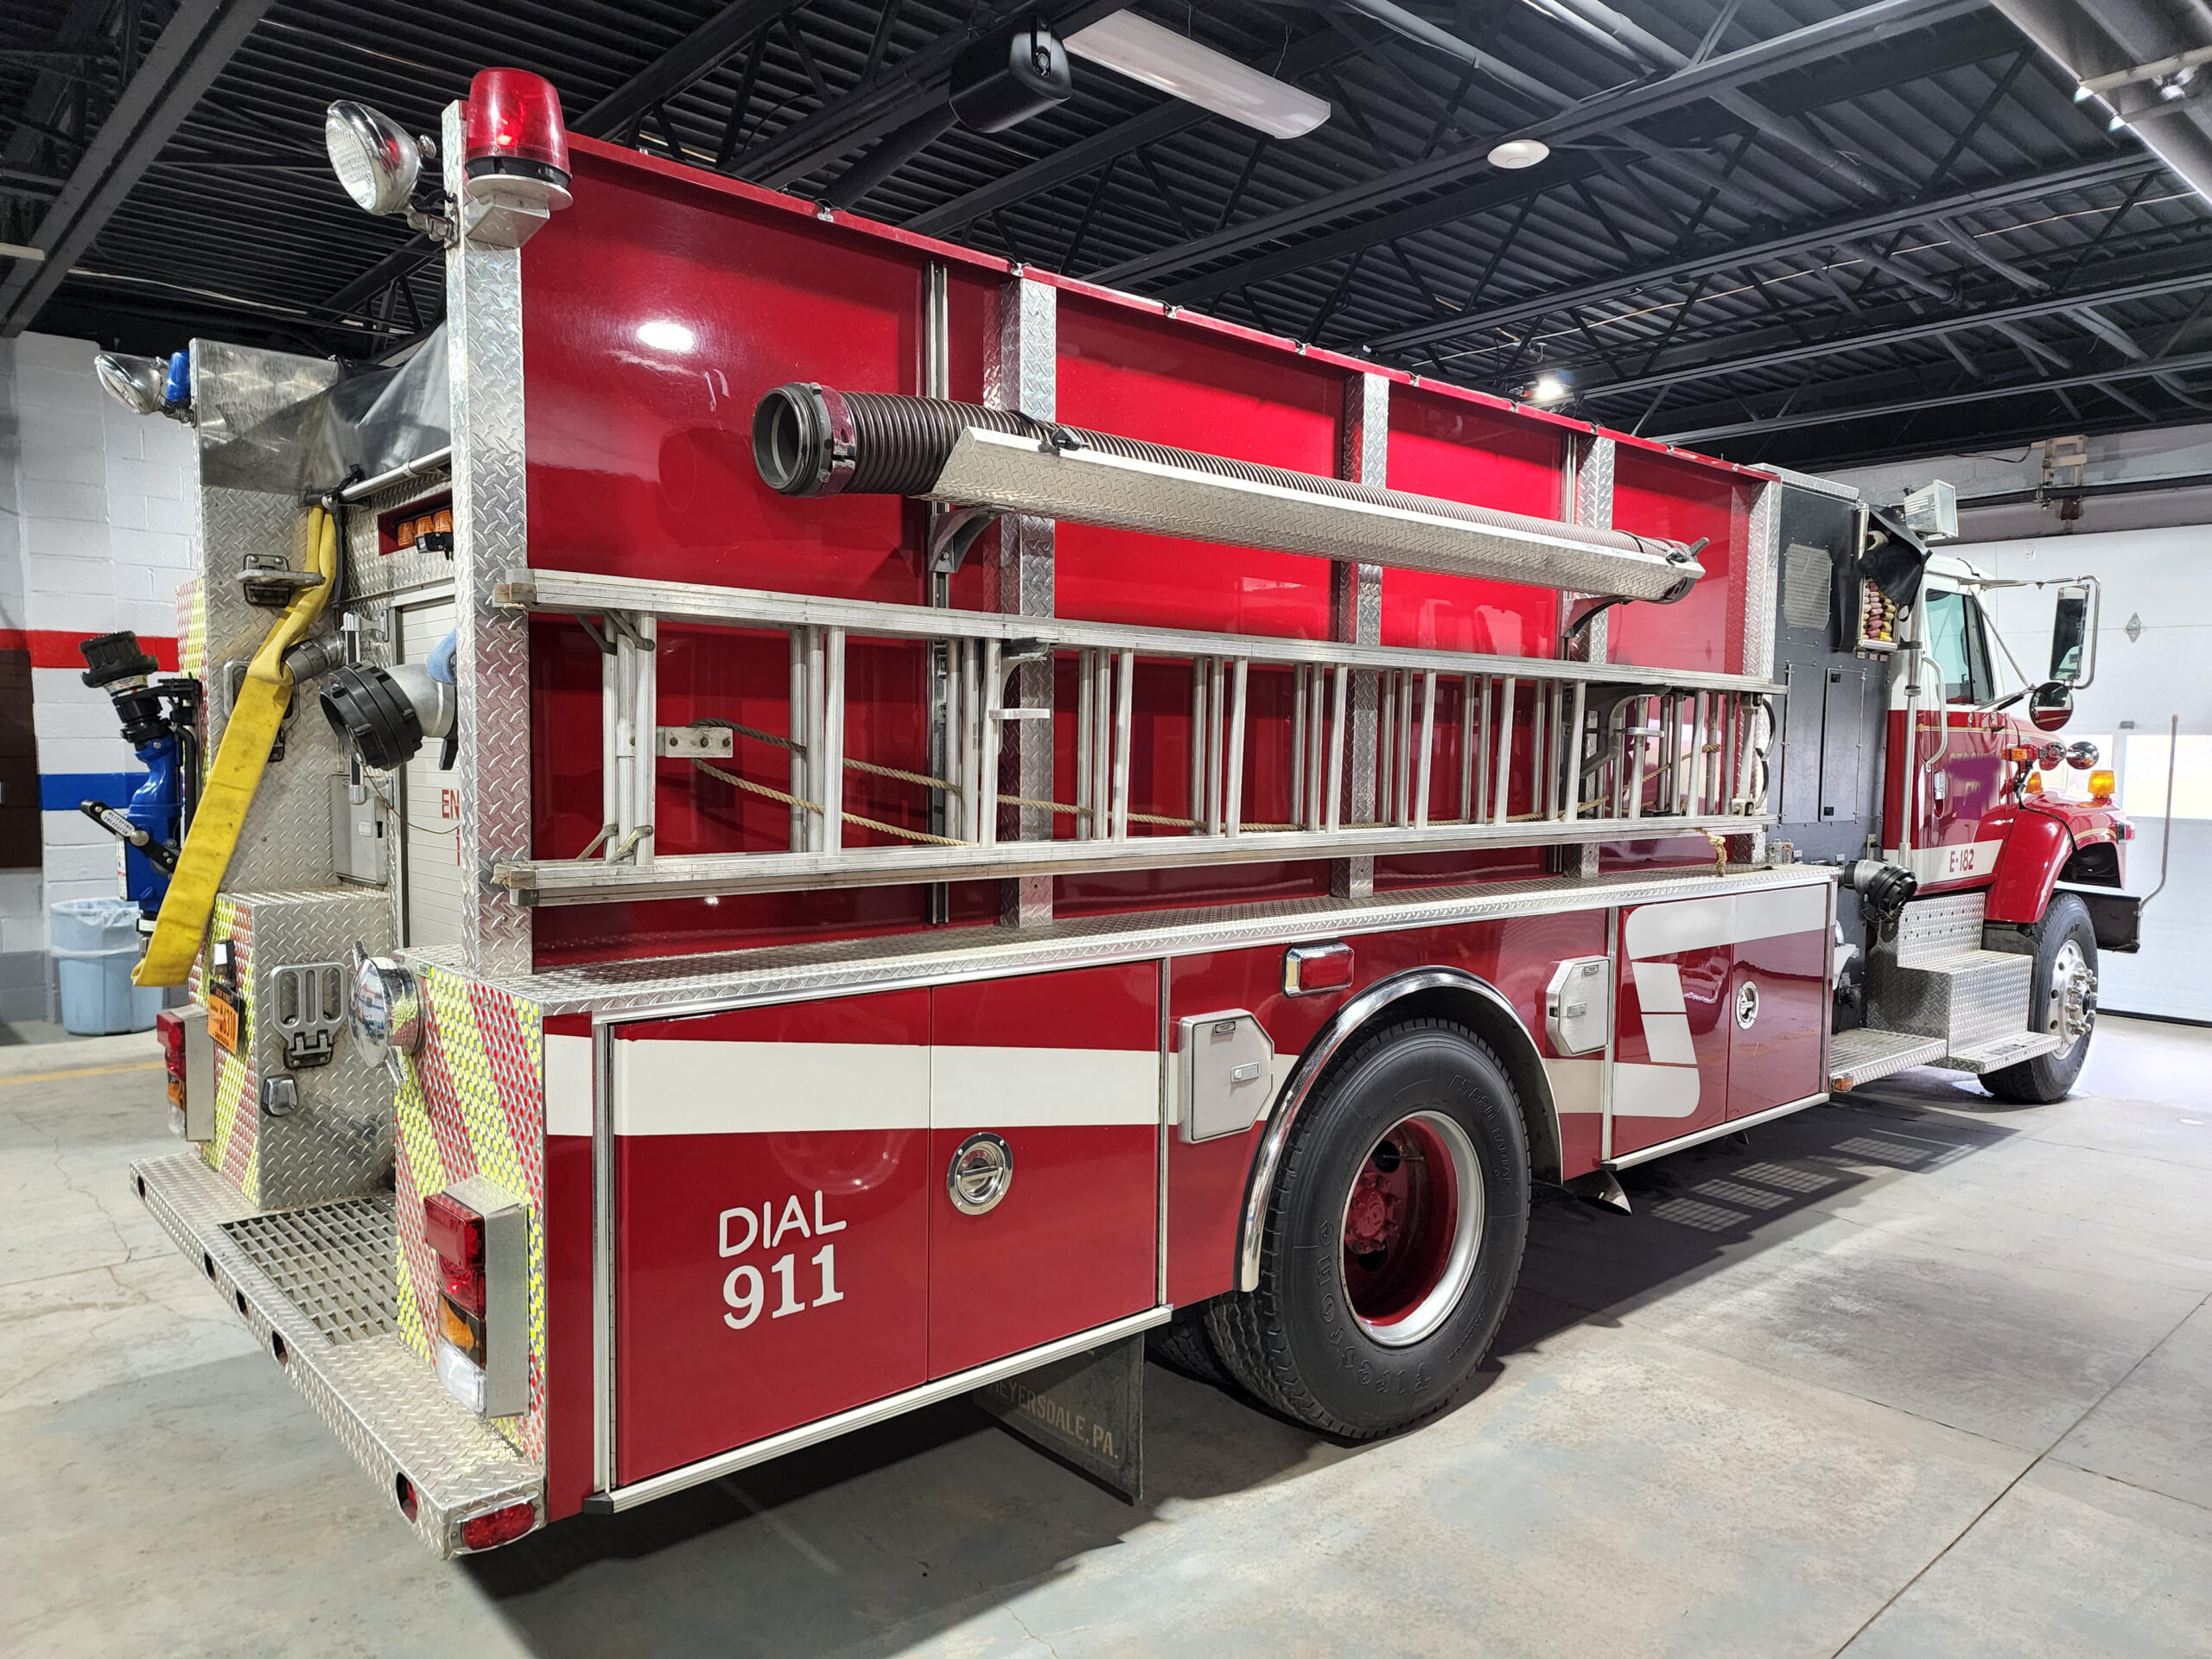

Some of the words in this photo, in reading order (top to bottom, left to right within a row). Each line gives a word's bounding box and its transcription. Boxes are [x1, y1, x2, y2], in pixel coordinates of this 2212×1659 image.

[1949, 849, 1974, 873] E-182
[719, 1190, 847, 1258] DIAL
[722, 1243, 844, 1330] 911
[1092, 1424, 1119, 1459] PA.
